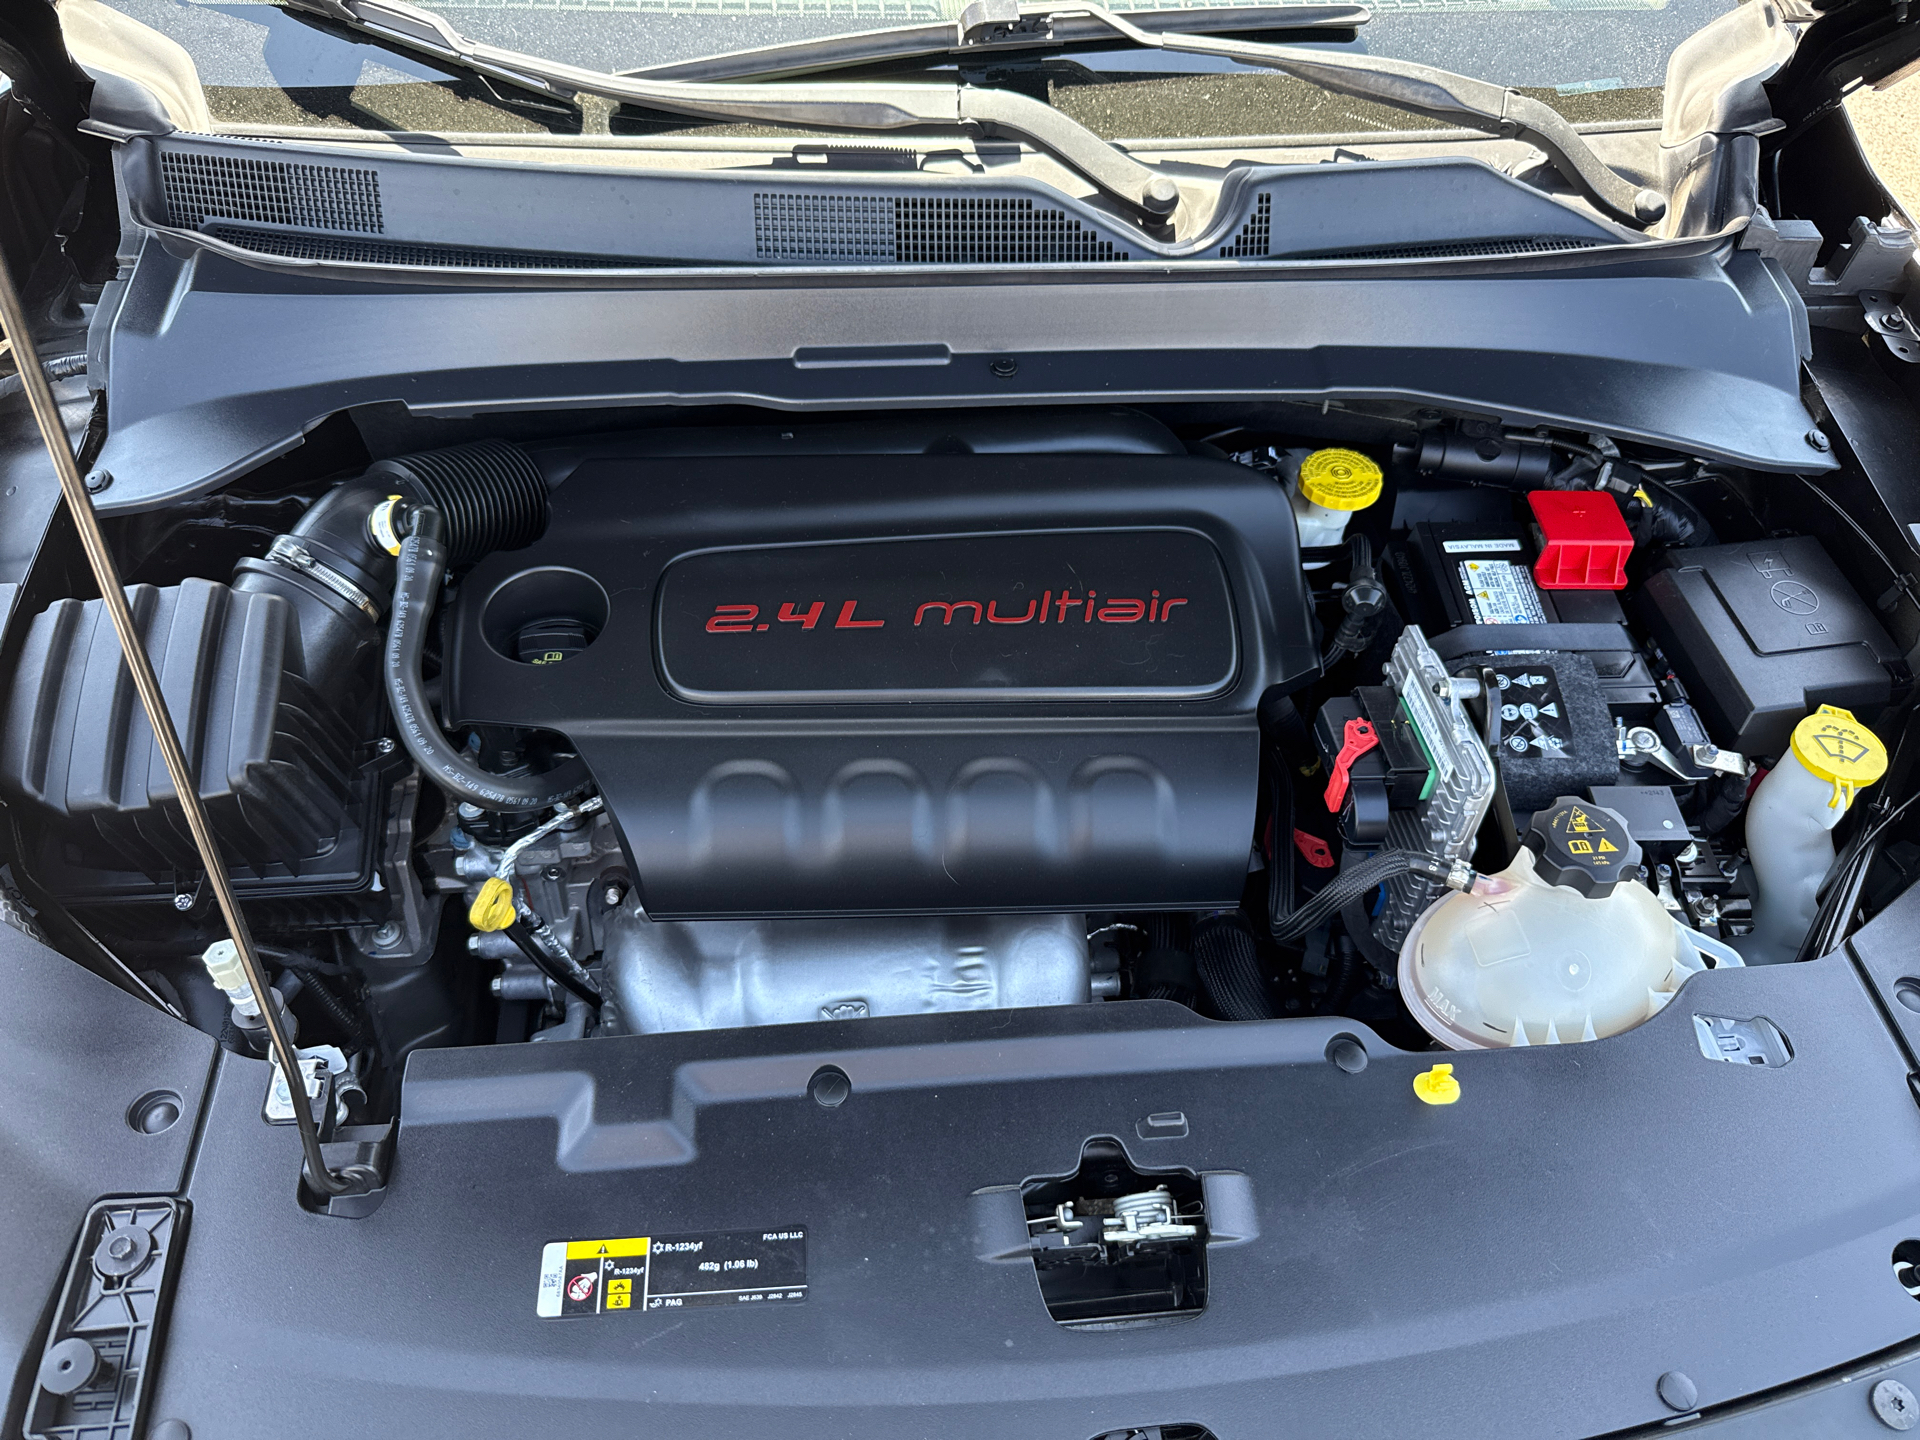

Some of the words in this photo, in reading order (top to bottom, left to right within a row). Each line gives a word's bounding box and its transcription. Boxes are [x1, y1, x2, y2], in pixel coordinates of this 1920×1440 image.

[1461, 579, 1473, 595] AGM
[914, 590, 1188, 625] multiair
[1468, 598, 1483, 625] POISON
[1427, 986, 1462, 1021] MAX
[762, 1232, 777, 1241] FCA
[778, 1232, 788, 1240] US
[789, 1231, 803, 1239] LLC
[665, 1241, 703, 1253] R-1234yf
[614, 1267, 645, 1276] R-1234yf
[698, 1262, 720, 1272] 482g
[723, 1260, 744, 1271] (1.06
[746, 1259, 758, 1270] lb)
[665, 1298, 682, 1307] PAG
